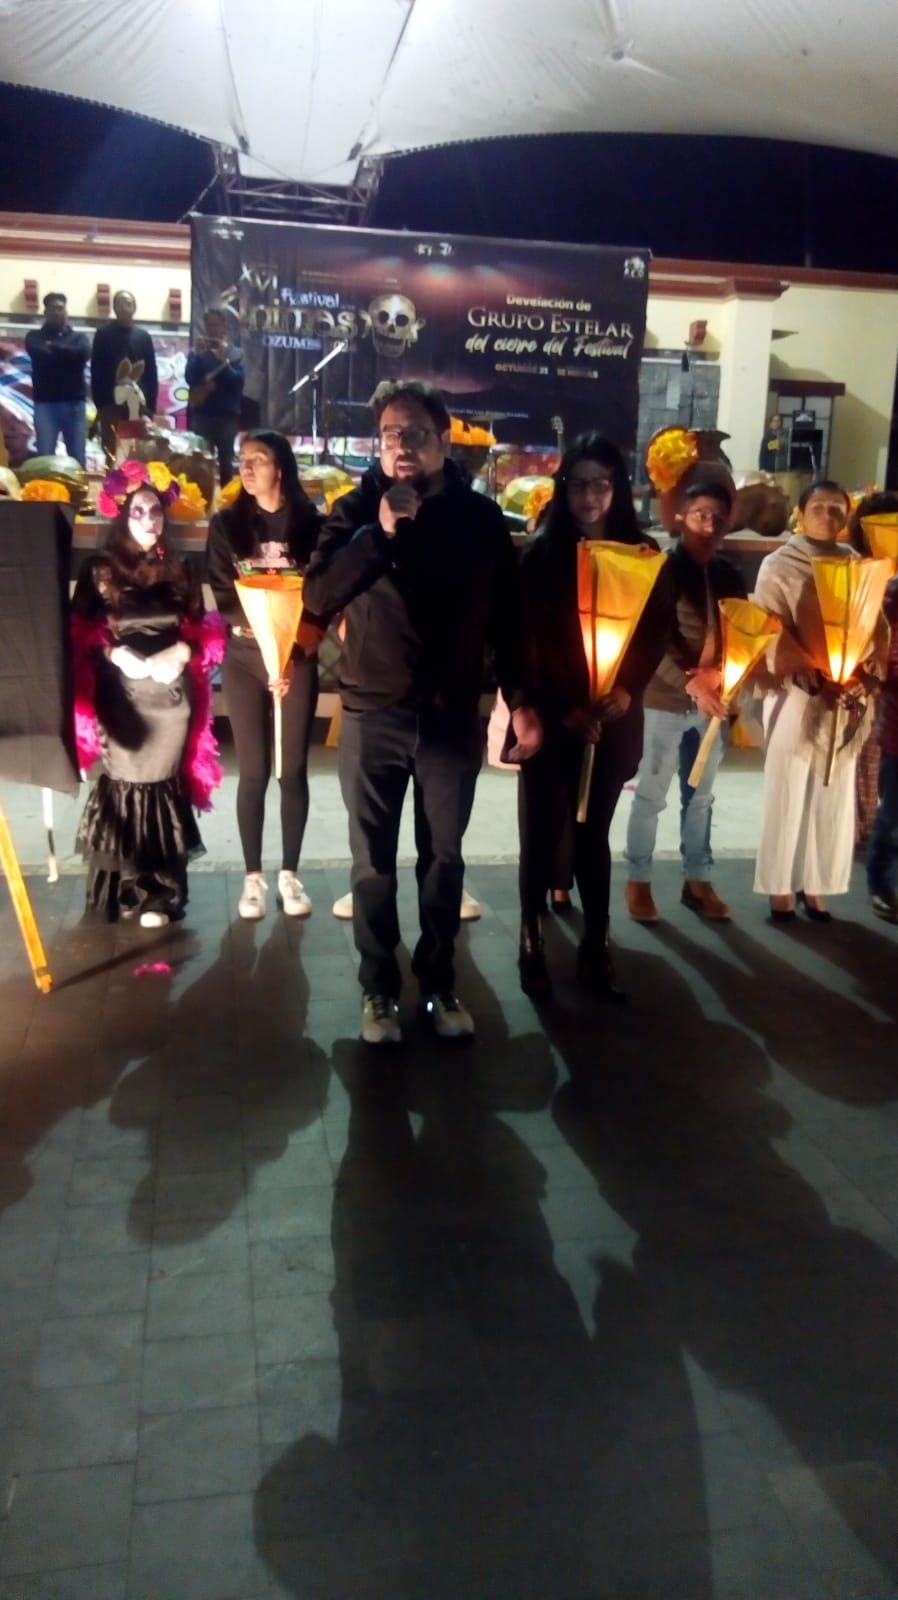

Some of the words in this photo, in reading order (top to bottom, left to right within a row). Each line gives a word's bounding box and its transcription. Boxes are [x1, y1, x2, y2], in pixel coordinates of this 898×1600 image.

[506, 294, 574, 311] Develación
[575, 300, 593, 312] de
[467, 306, 544, 331] GRUPO
[550, 314, 634, 339] ESTELAR
[465, 333, 490, 354] del
[494, 336, 538, 354] cierre
[542, 336, 570, 357] del
[573, 335, 633, 359] Festival
